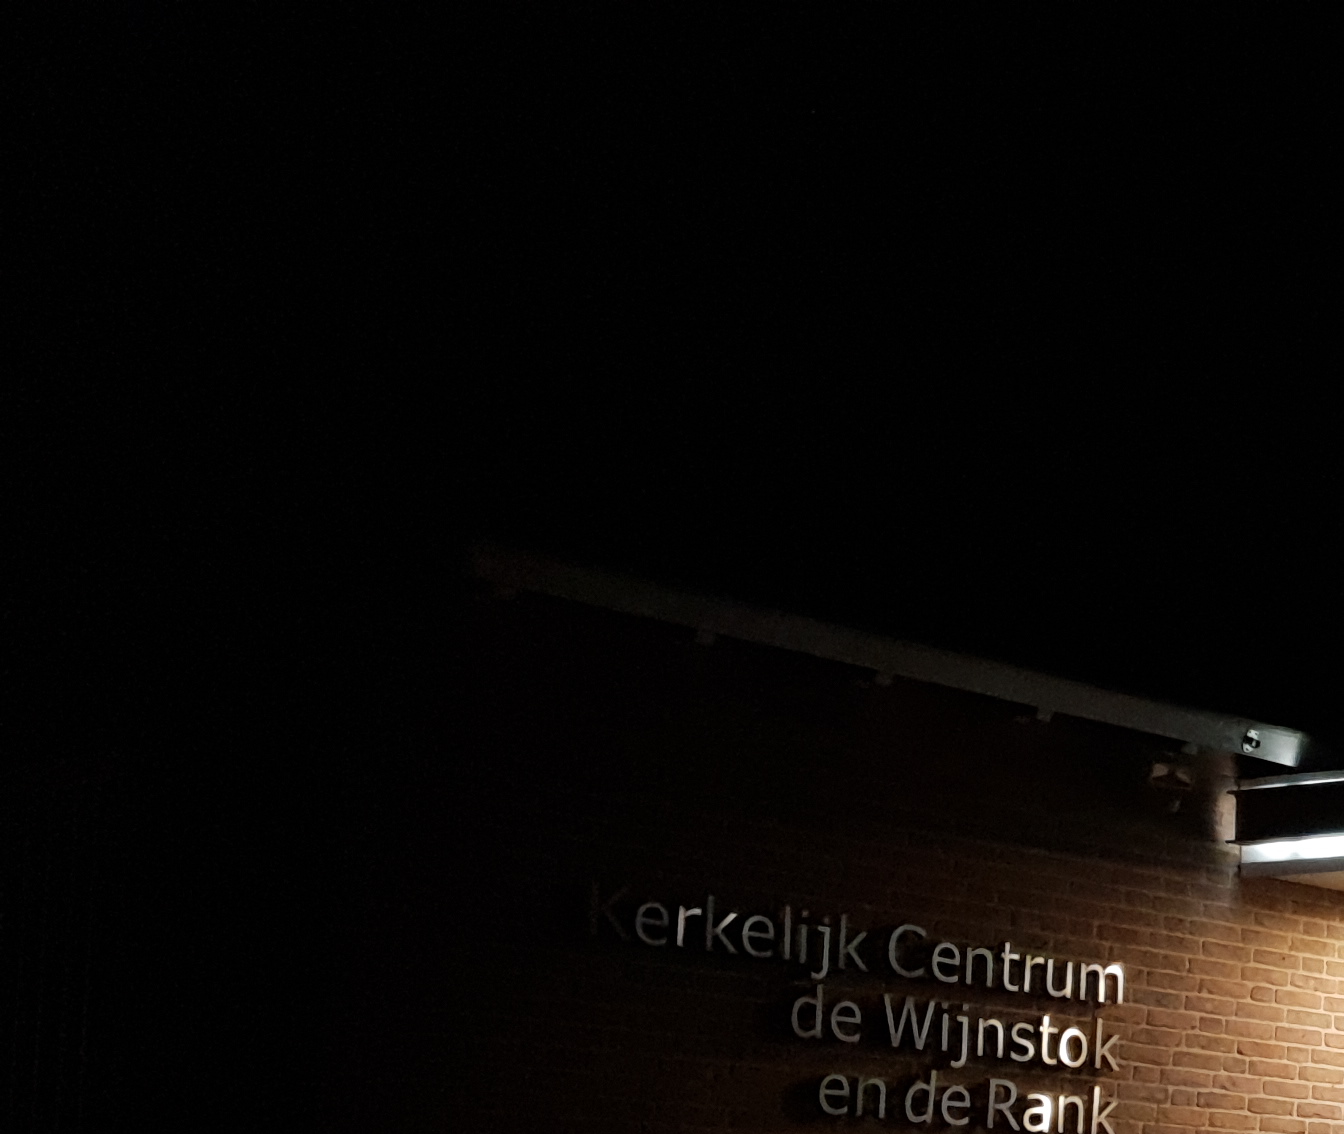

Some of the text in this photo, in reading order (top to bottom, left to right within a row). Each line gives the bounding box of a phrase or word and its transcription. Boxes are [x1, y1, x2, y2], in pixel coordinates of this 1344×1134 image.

[591, 880, 1125, 1005] Kerkelijk Centrum
[791, 984, 1121, 1072] de Wijnstok
[818, 1073, 886, 1119] en
[904, 1069, 971, 1127] de
